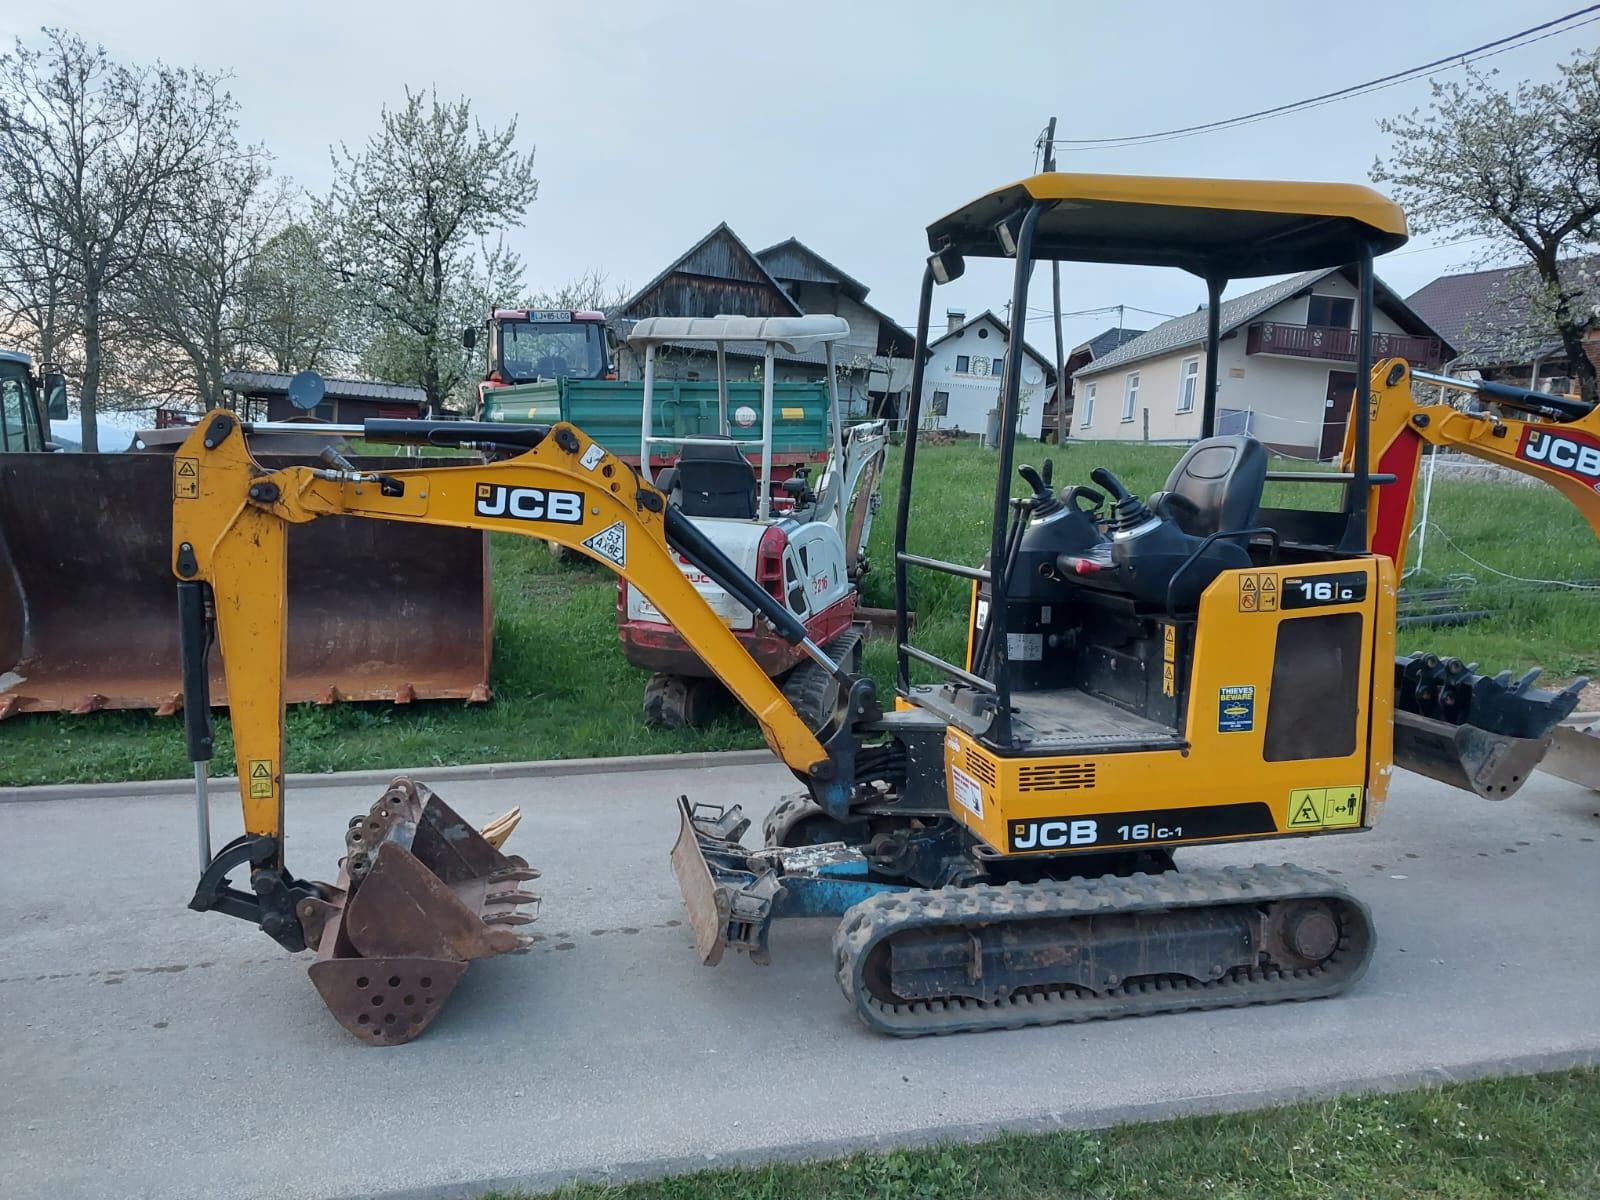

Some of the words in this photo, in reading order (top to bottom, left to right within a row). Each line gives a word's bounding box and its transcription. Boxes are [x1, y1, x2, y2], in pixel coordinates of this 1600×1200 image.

[1526, 433, 1600, 476] JCB
[477, 486, 581, 522] JCB
[606, 531, 621, 545] 53
[1015, 820, 1098, 849] JCB
